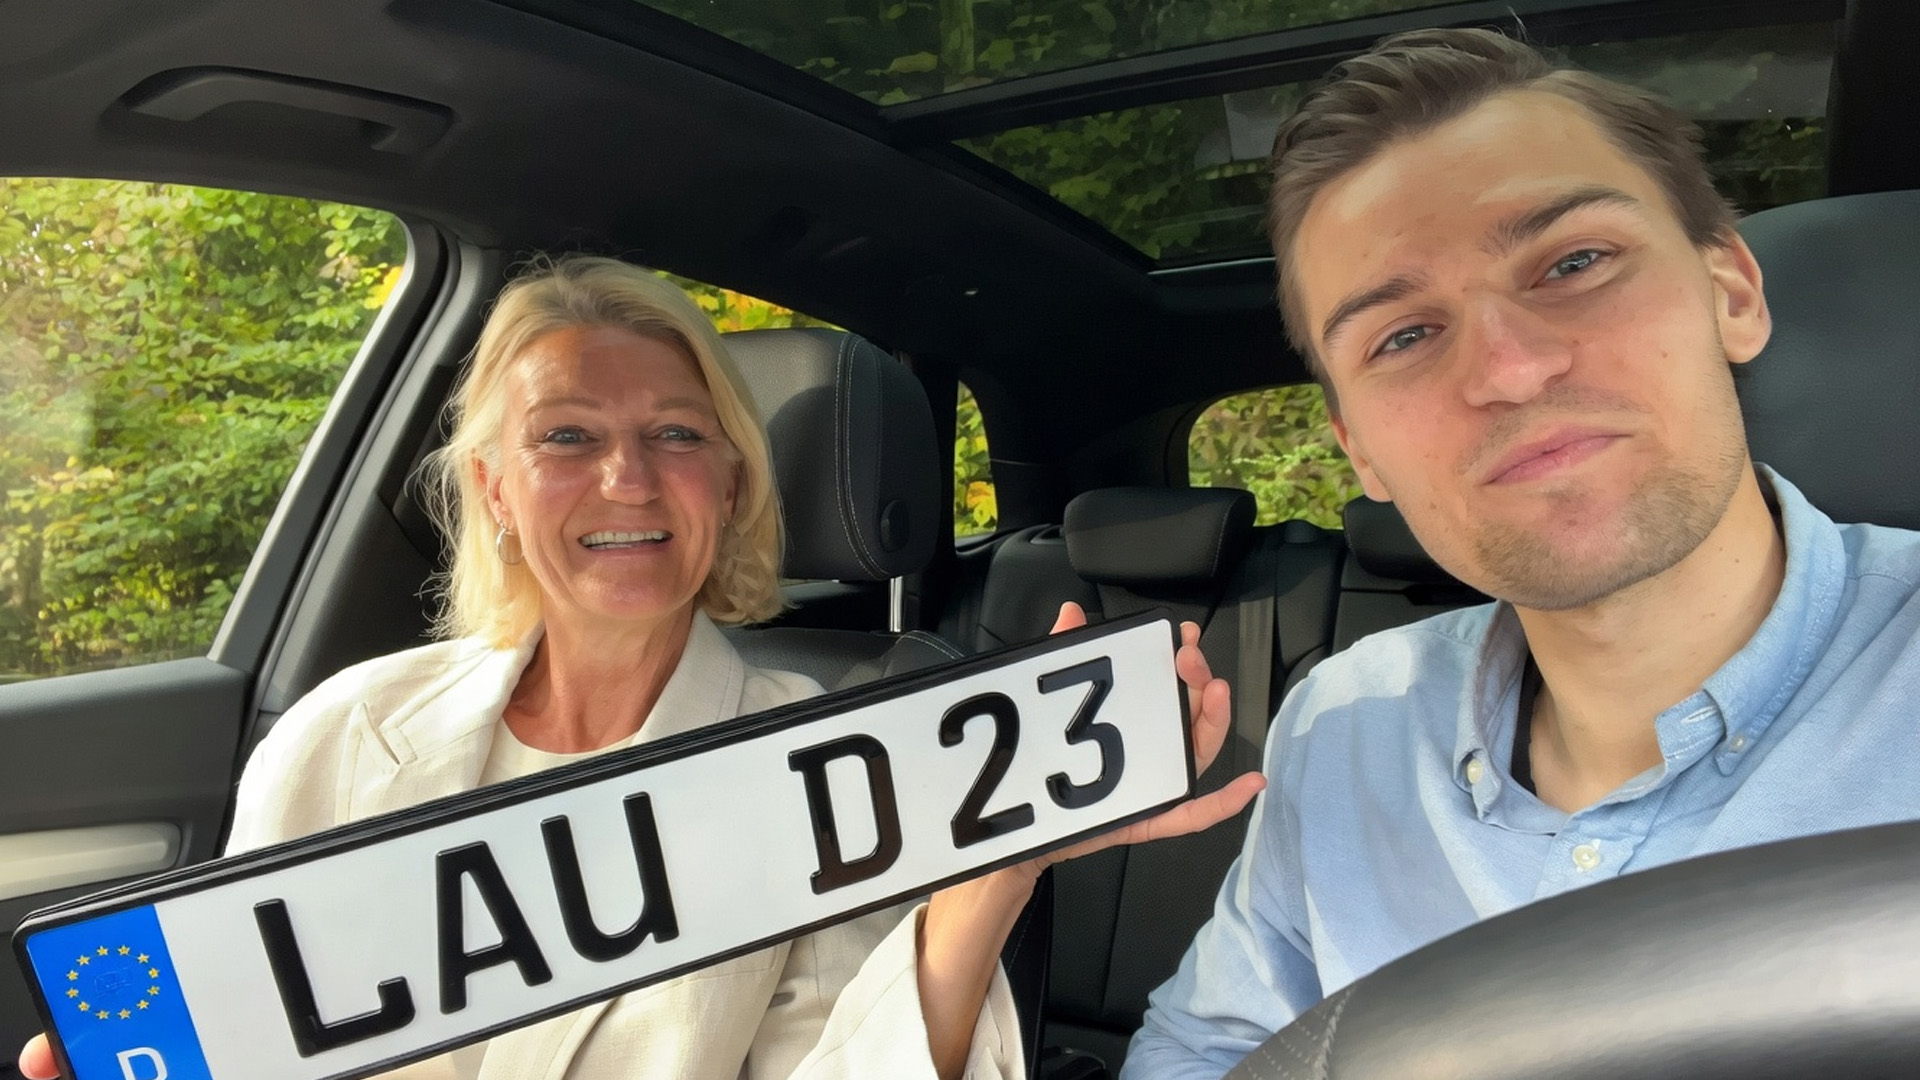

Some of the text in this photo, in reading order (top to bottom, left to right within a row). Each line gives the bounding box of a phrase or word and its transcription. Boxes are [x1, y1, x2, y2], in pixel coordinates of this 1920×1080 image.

[253, 655, 1126, 1058] LAU D 23
[116, 1046, 168, 1080] D
